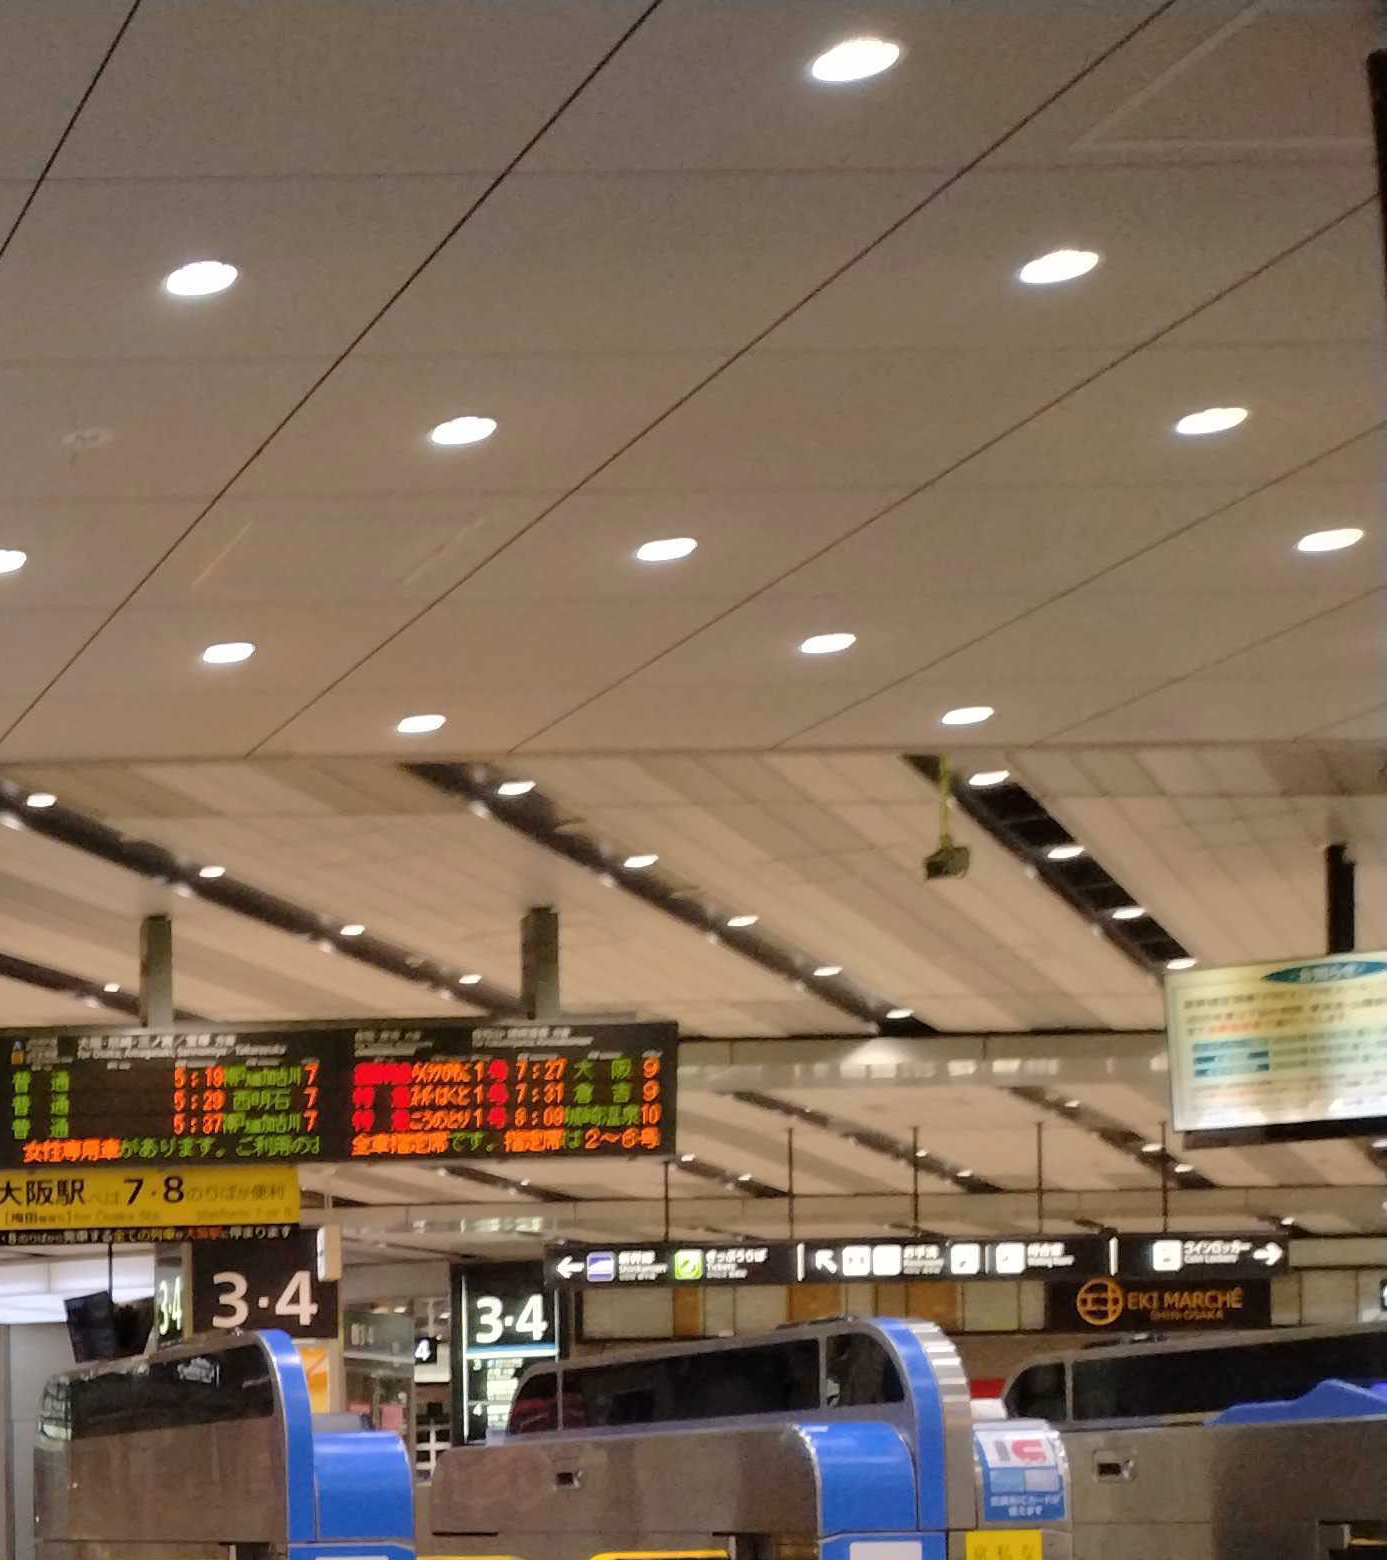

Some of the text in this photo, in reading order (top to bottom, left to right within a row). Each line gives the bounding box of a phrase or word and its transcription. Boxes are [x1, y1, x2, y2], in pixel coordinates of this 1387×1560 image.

[305, 1063, 319, 1085] 7
[233, 1088, 291, 1111] 西明石
[303, 1088, 318, 1108] 7
[304, 1110, 318, 1132] 7
[642, 1104, 661, 1124] 10
[1127, 1290, 1162, 1310] EKI
[414, 1339, 431, 1361] 4
